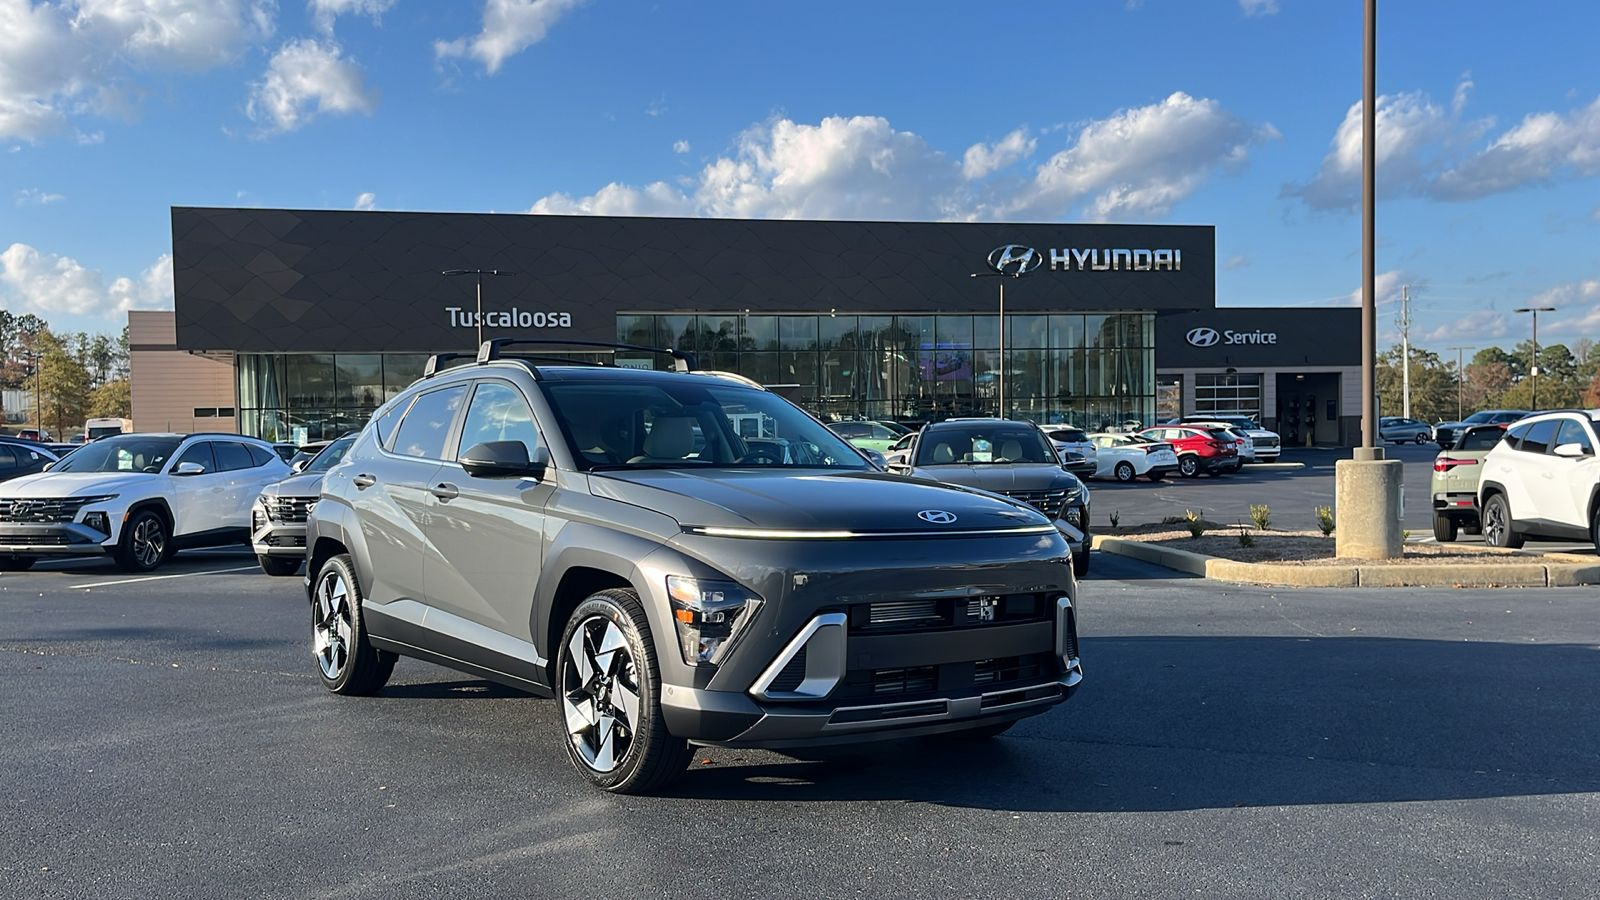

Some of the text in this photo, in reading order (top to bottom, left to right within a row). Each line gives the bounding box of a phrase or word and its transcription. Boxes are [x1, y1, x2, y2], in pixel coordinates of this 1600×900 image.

[1050, 248, 1181, 271] HYUNDAI
[445, 307, 572, 328] Tuscaloosa
[1223, 329, 1277, 345] Service
